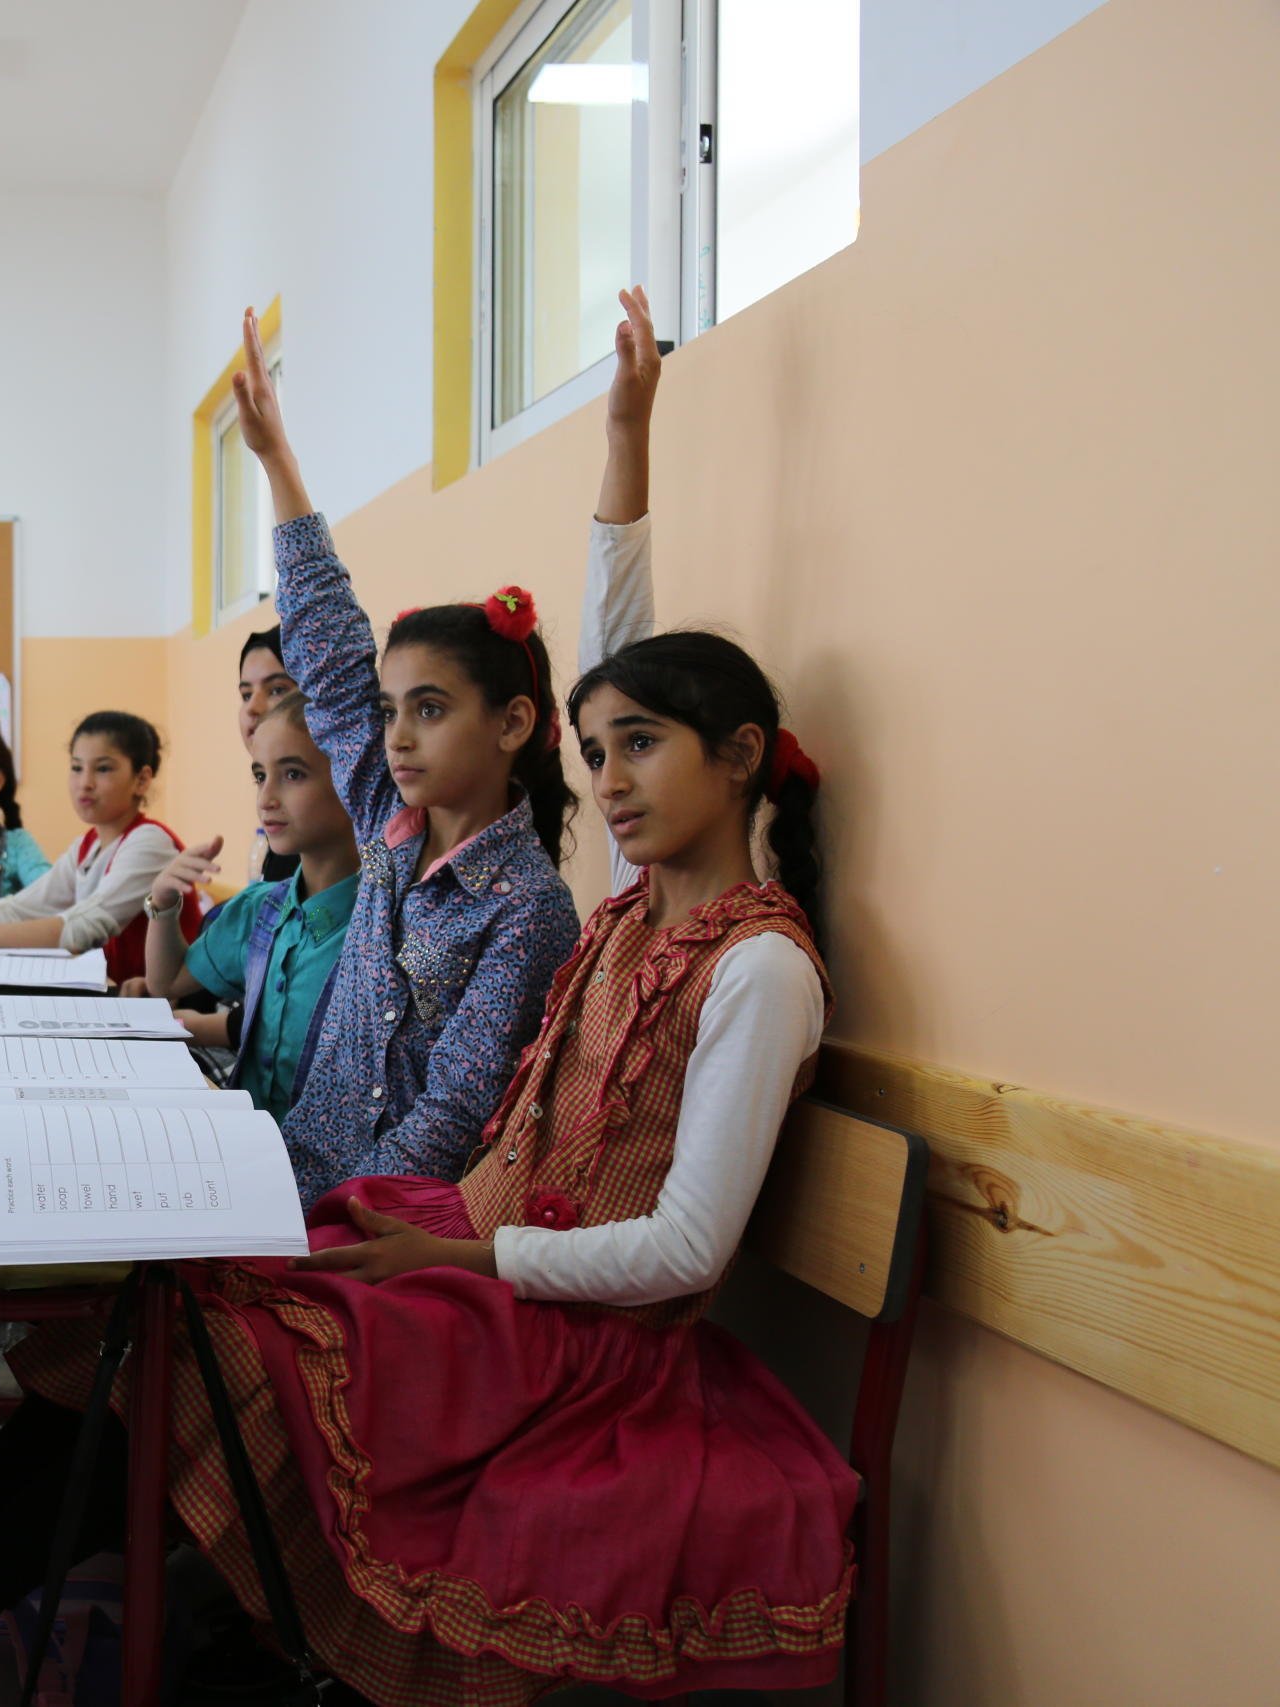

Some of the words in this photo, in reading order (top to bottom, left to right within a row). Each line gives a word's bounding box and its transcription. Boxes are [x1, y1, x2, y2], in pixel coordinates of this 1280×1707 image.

[6, 1174, 14, 1188] each
[7, 1189, 16, 1214] Practice
[36, 1184, 46, 1211] water
[57, 1187, 68, 1210] soap
[81, 1184, 92, 1209] towel
[106, 1184, 118, 1209] hand
[132, 1191, 143, 1209] wet
[157, 1192, 169, 1208] put
[182, 1192, 194, 1208] rub
[206, 1180, 219, 1208] count
